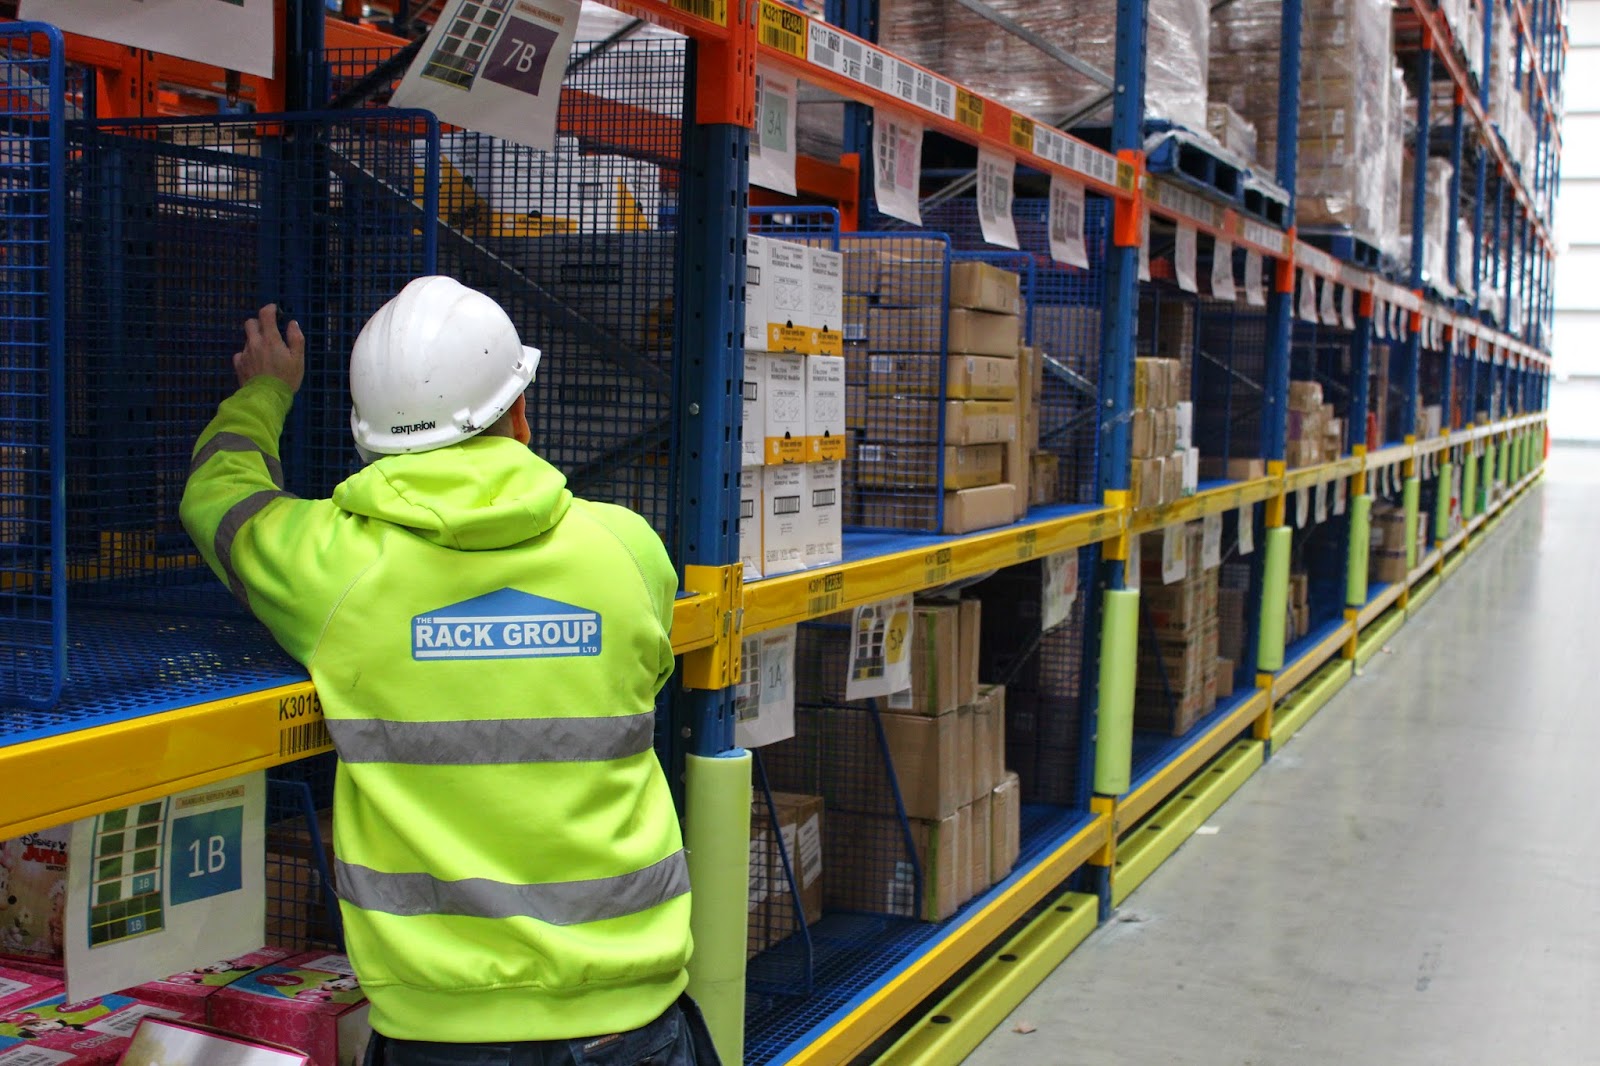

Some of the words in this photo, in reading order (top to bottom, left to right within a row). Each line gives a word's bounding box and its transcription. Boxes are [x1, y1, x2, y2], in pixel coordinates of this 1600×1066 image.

[503, 38, 536, 73] 7B
[767, 111, 782, 137] 3A
[391, 420, 436, 435] CENTURION
[416, 624, 495, 648] RACK
[502, 621, 597, 646] GROUP
[582, 646, 597, 654] LTD
[768, 664, 782, 689] 1A
[279, 692, 320, 721] K3015
[188, 835, 226, 878] 1B
[138, 878, 150, 889] 1B
[130, 920, 142, 931] 1B
